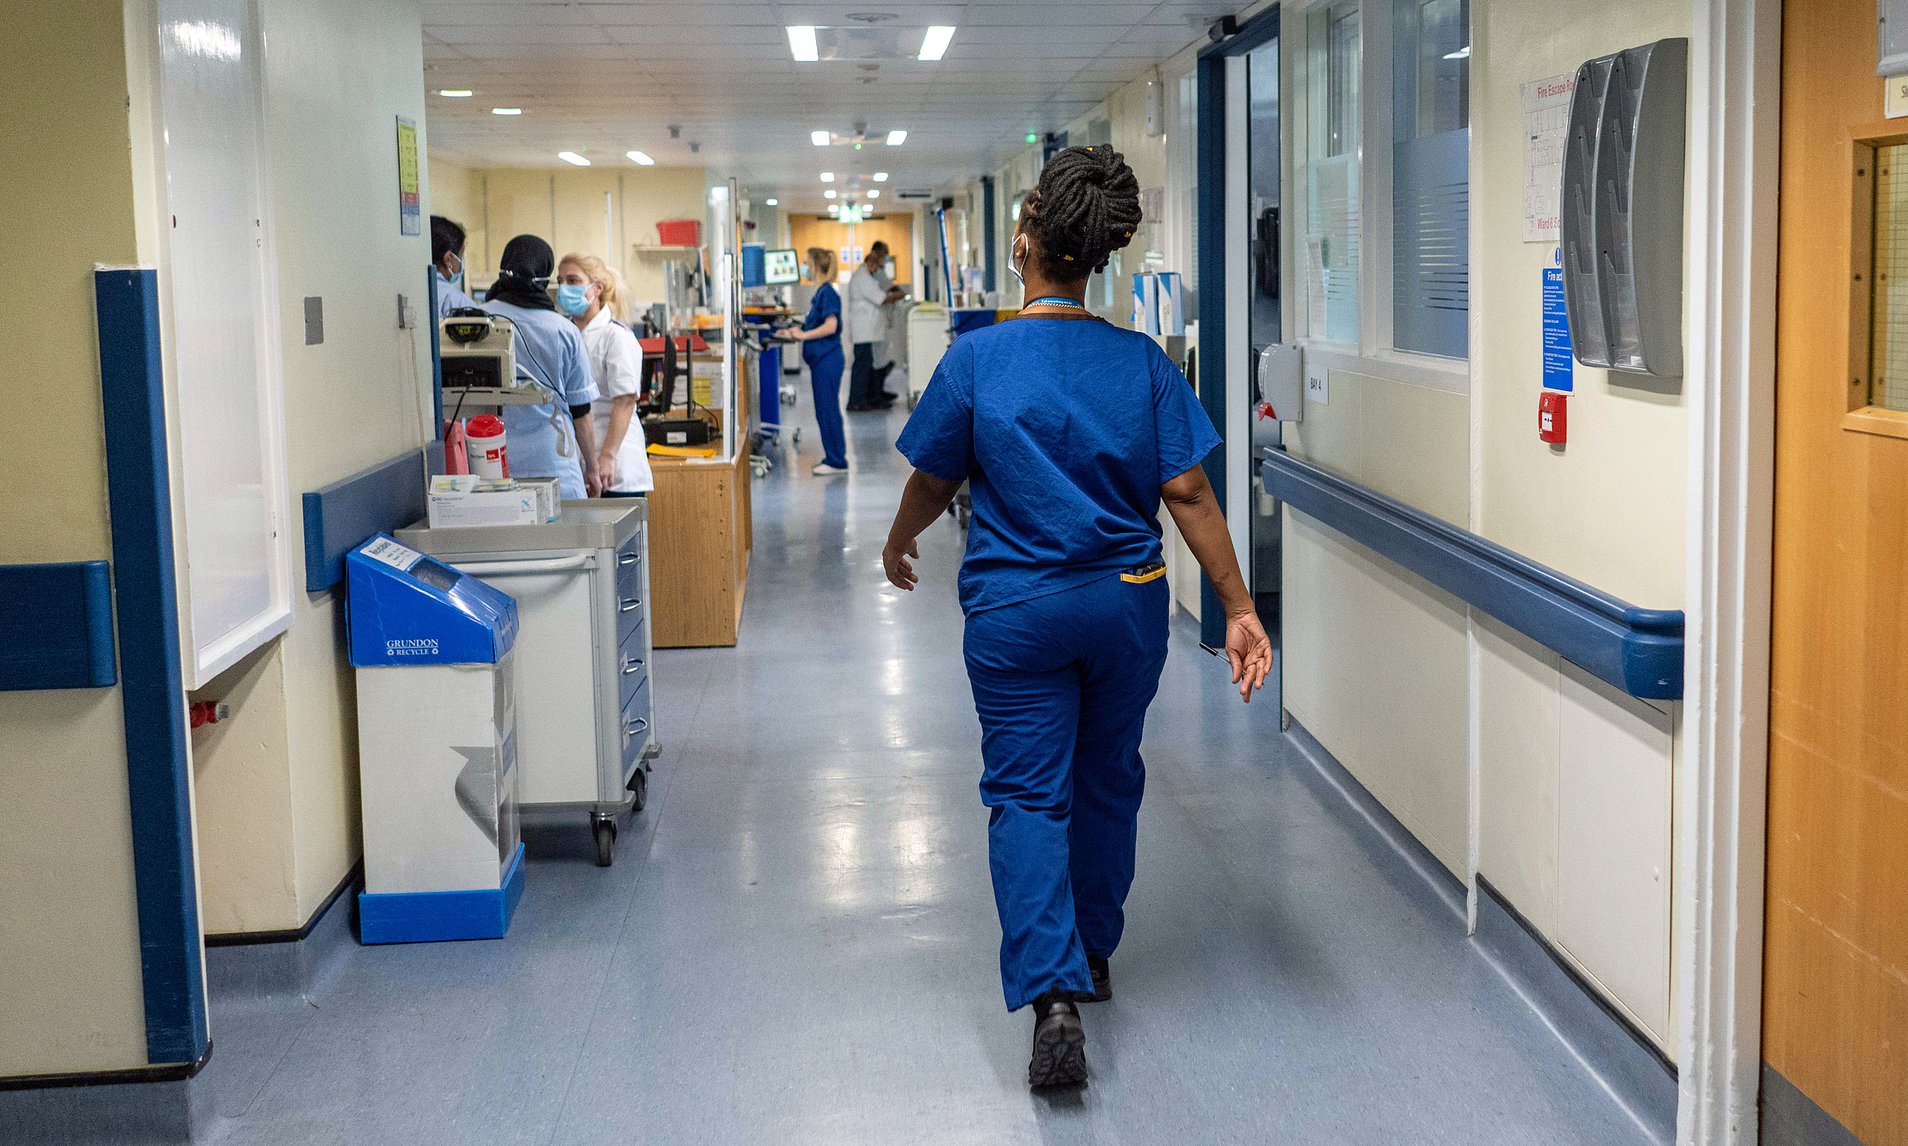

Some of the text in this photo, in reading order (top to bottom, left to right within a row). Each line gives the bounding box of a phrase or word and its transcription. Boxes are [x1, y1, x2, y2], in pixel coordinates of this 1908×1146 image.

[1537, 86, 1548, 97] Fire
[1548, 83, 1566, 96] Escape
[1547, 271, 1556, 281] Fire
[386, 639, 439, 649] GRUNDON
